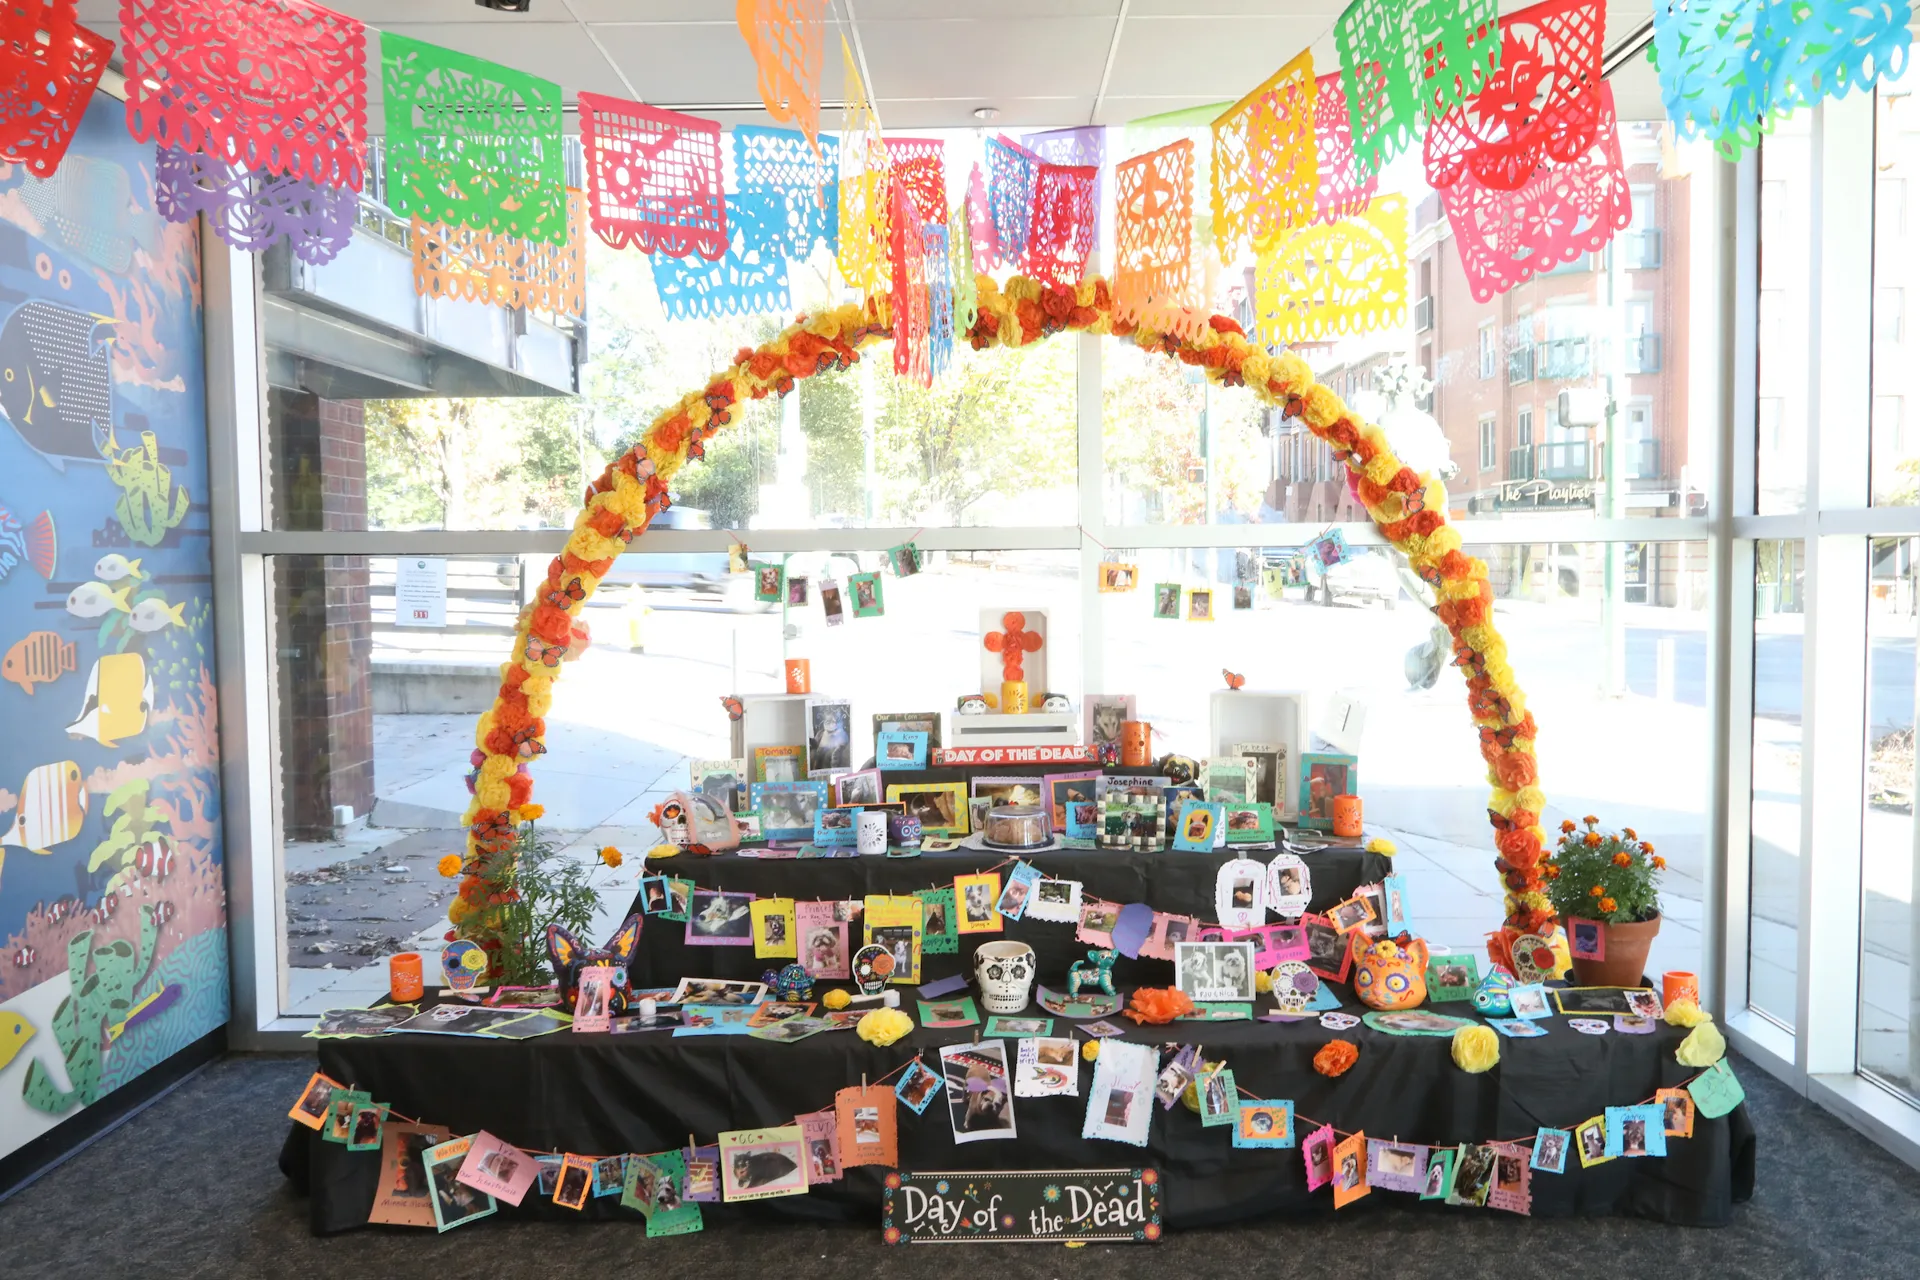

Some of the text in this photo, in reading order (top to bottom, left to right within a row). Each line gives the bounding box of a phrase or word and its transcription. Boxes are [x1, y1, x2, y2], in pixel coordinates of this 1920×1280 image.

[1491, 479, 1526, 502] The
[945, 746, 1086, 762] DAY OF THE DEAD
[1107, 777, 1154, 787] Josephine
[901, 1179, 1147, 1235] Day of the Dead
